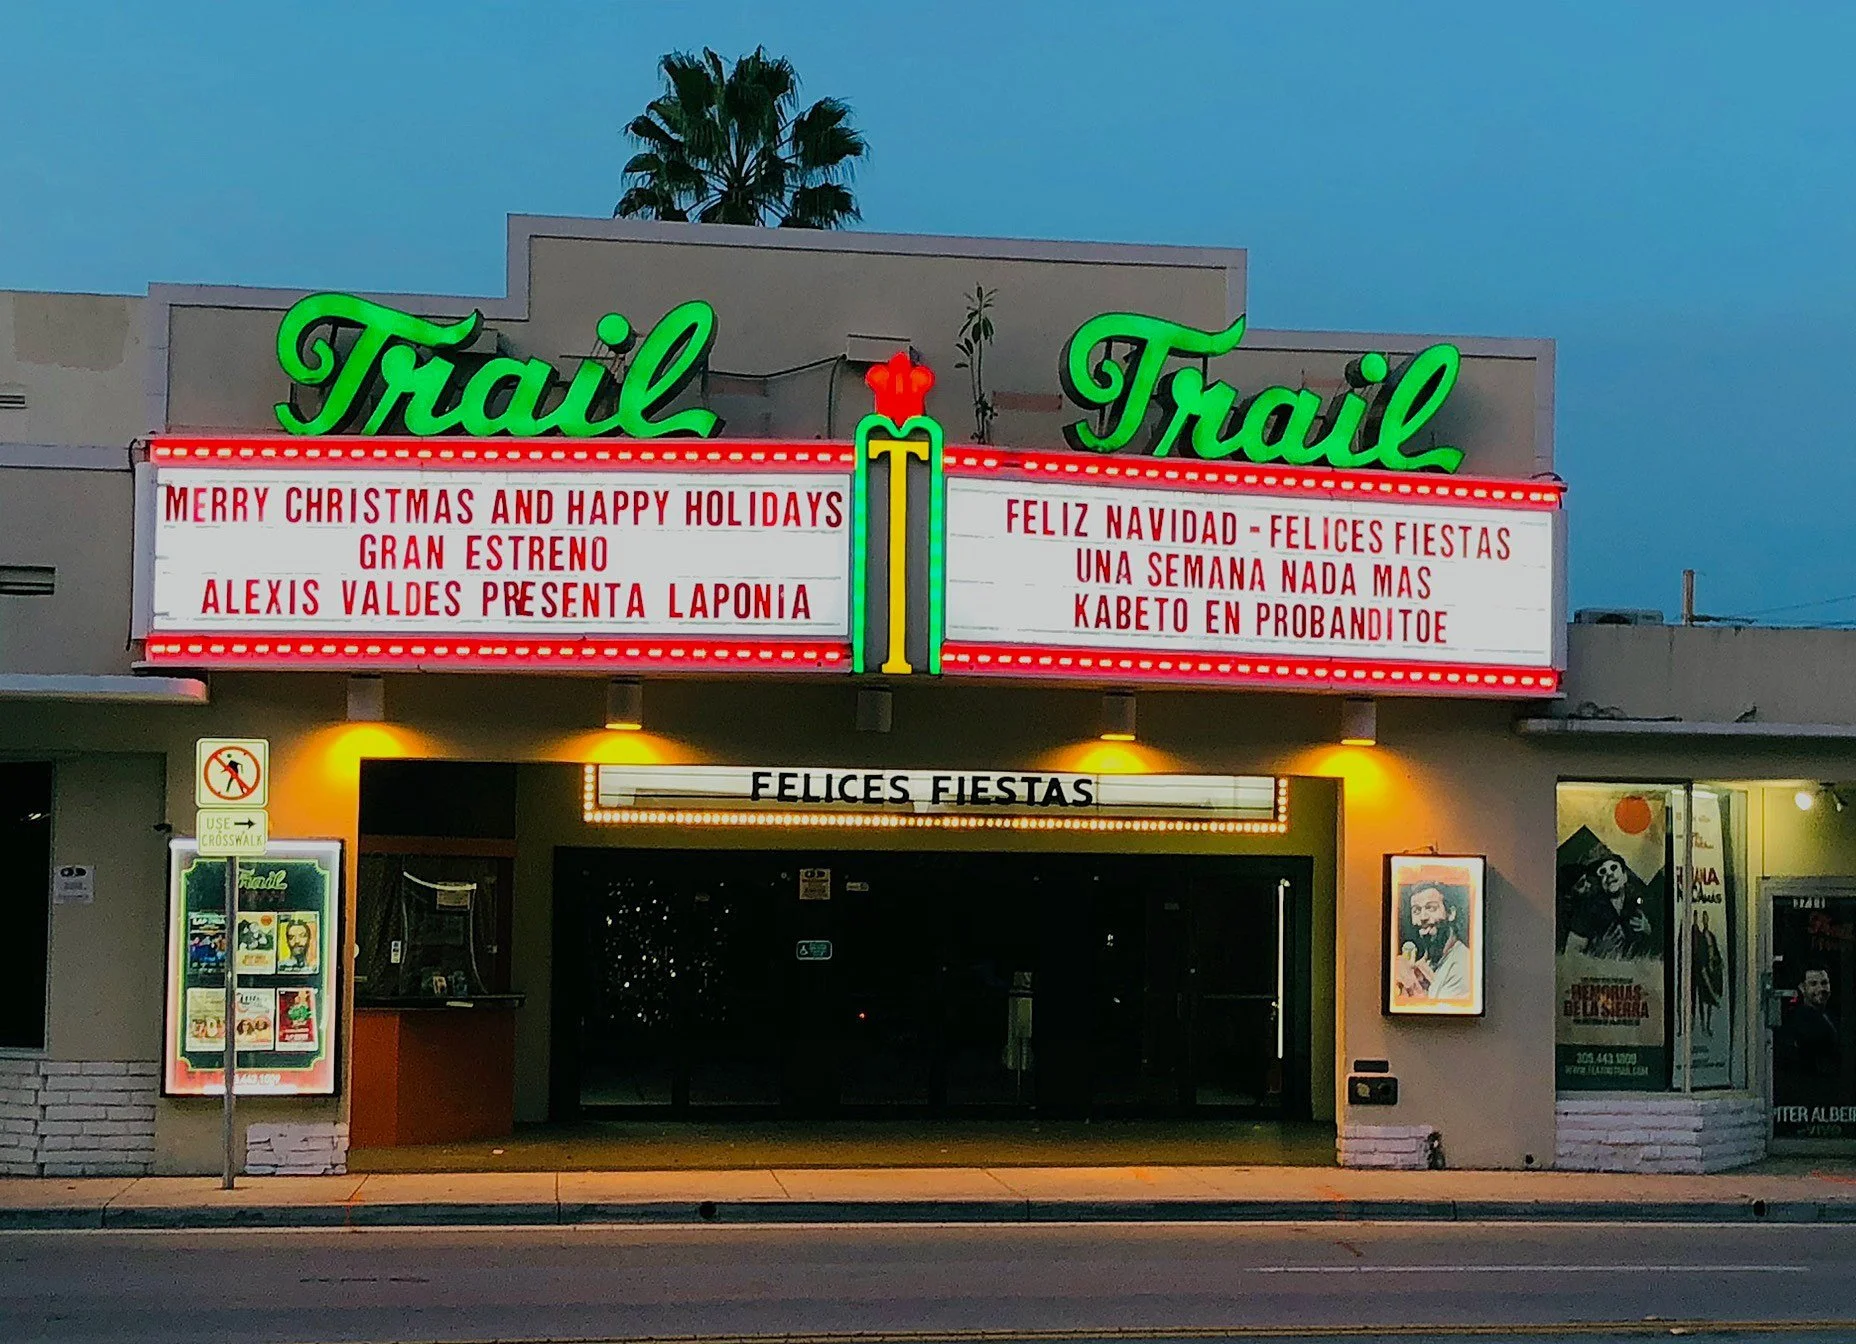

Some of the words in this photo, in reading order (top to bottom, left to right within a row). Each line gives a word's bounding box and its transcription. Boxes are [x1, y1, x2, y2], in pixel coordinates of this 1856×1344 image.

[274, 292, 722, 438] Trail
[1062, 312, 1465, 474] Trail
[165, 484, 269, 524] MERRY
[285, 486, 475, 525] CHRISTMAS
[491, 488, 554, 526] AND
[567, 489, 670, 526] HAPPY
[685, 490, 843, 529] HOLIDAYS
[1006, 498, 1089, 538] FELIZ
[1106, 505, 1237, 546] NAVIDAD
[1395, 521, 1511, 561] FIESTAS
[359, 533, 444, 571] GRAN
[465, 534, 608, 573] ESTRENO
[1076, 548, 1133, 585] UNA
[1147, 551, 1266, 592] SEMANA
[1281, 559, 1357, 597] NADA
[1373, 563, 1432, 600] MAS
[201, 578, 320, 617] ALEXIS
[341, 580, 462, 618] VALDES
[482, 580, 646, 619] PRESENTA
[668, 582, 811, 620] LAPONIA
[1074, 593, 1189, 634] KABETO
[1205, 599, 1241, 635] EN
[1256, 602, 1448, 644] PROBANDITOE
[751, 771, 910, 805] FELICES
[932, 775, 1093, 807] FIESTAS
[201, 834, 262, 847] CROSSWALK
[206, 817, 231, 830] USE
